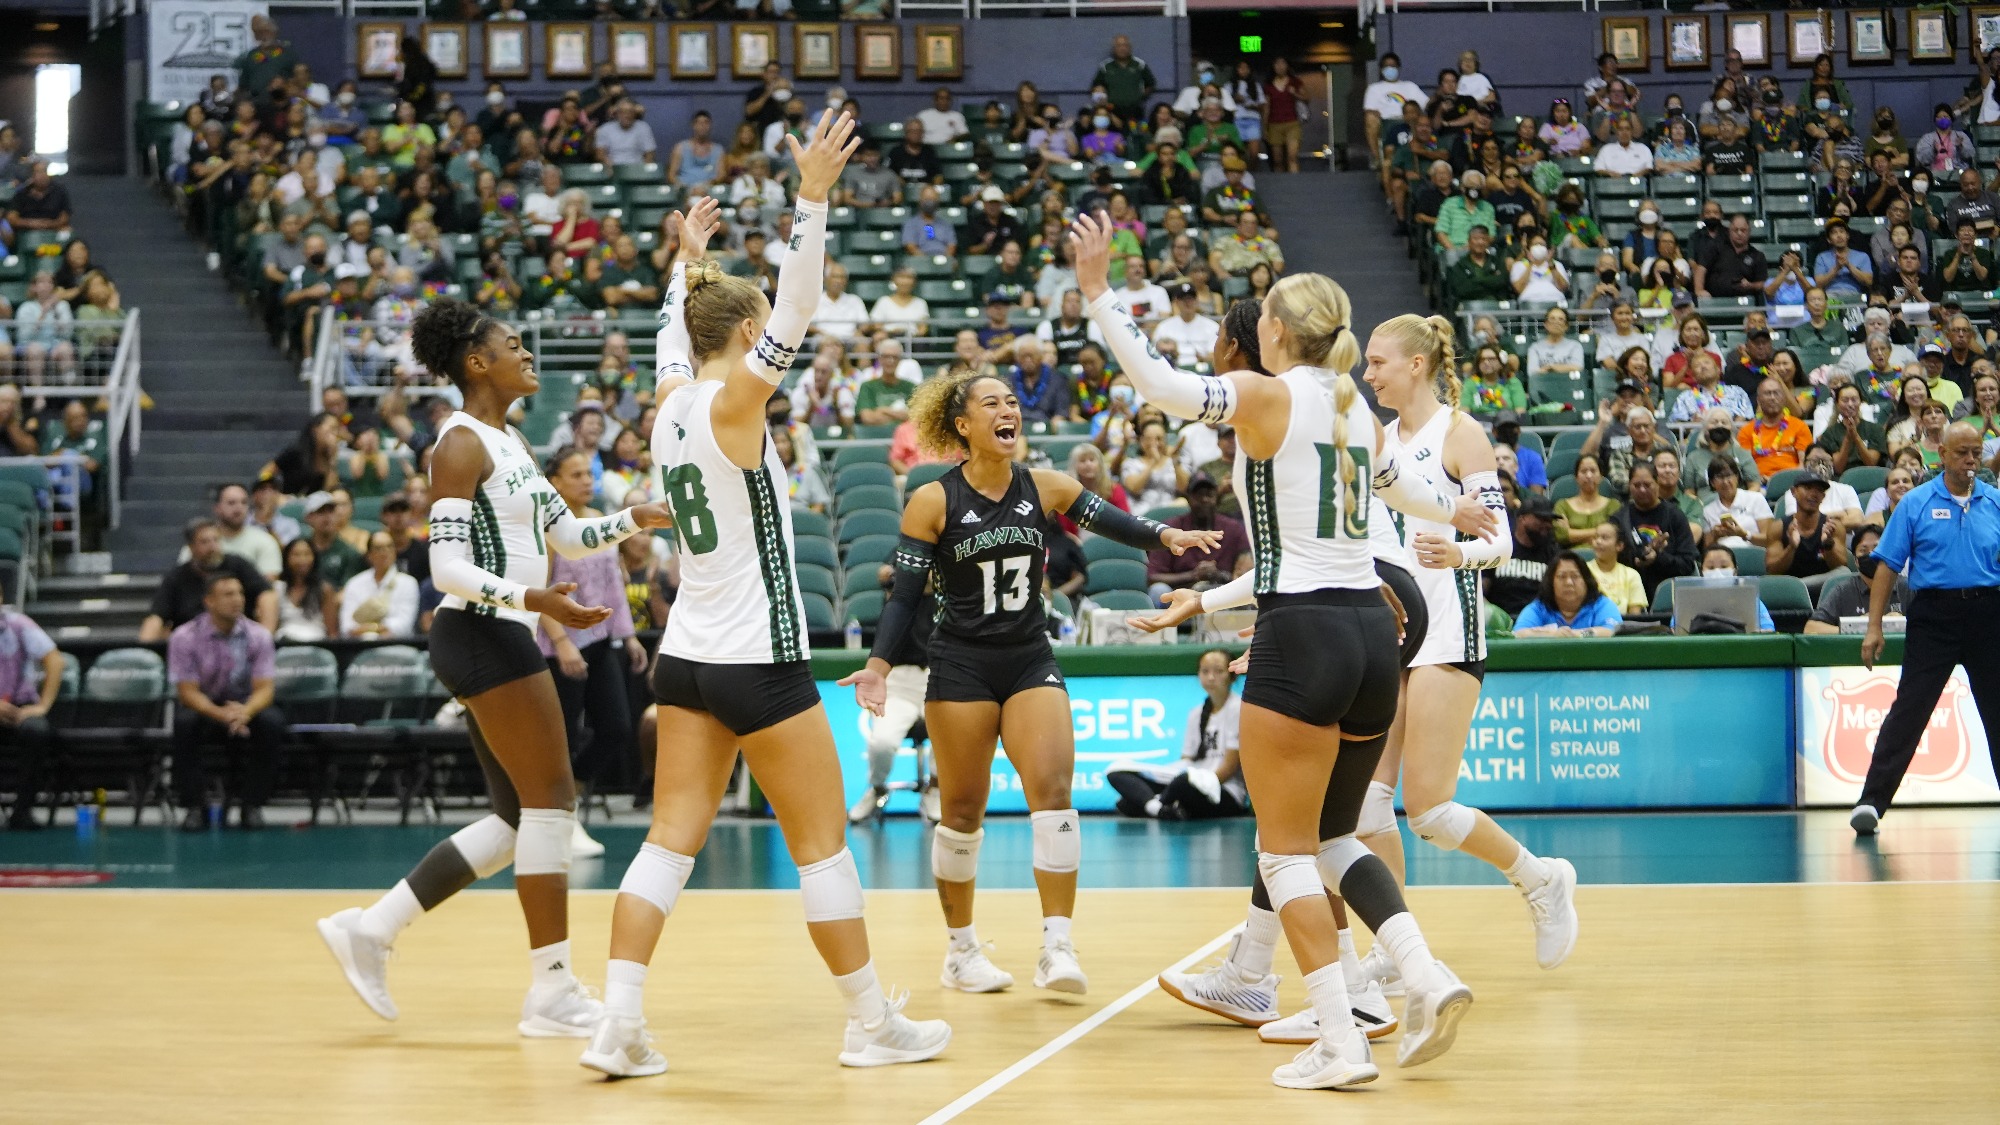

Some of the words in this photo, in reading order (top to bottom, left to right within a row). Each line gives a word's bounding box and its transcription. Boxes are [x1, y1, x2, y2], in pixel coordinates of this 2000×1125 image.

[1313, 441, 1371, 540] 10
[976, 554, 1032, 615] 13
[1472, 697, 1525, 720] AI'I
[1550, 718, 1588, 734] PALI
[1593, 717, 1641, 733] MOMI
[1464, 727, 1526, 750] IFIC
[1550, 740, 1621, 758] STRAUB
[1457, 757, 1526, 782] ALTH
[1550, 763, 1621, 780] WILCOX
